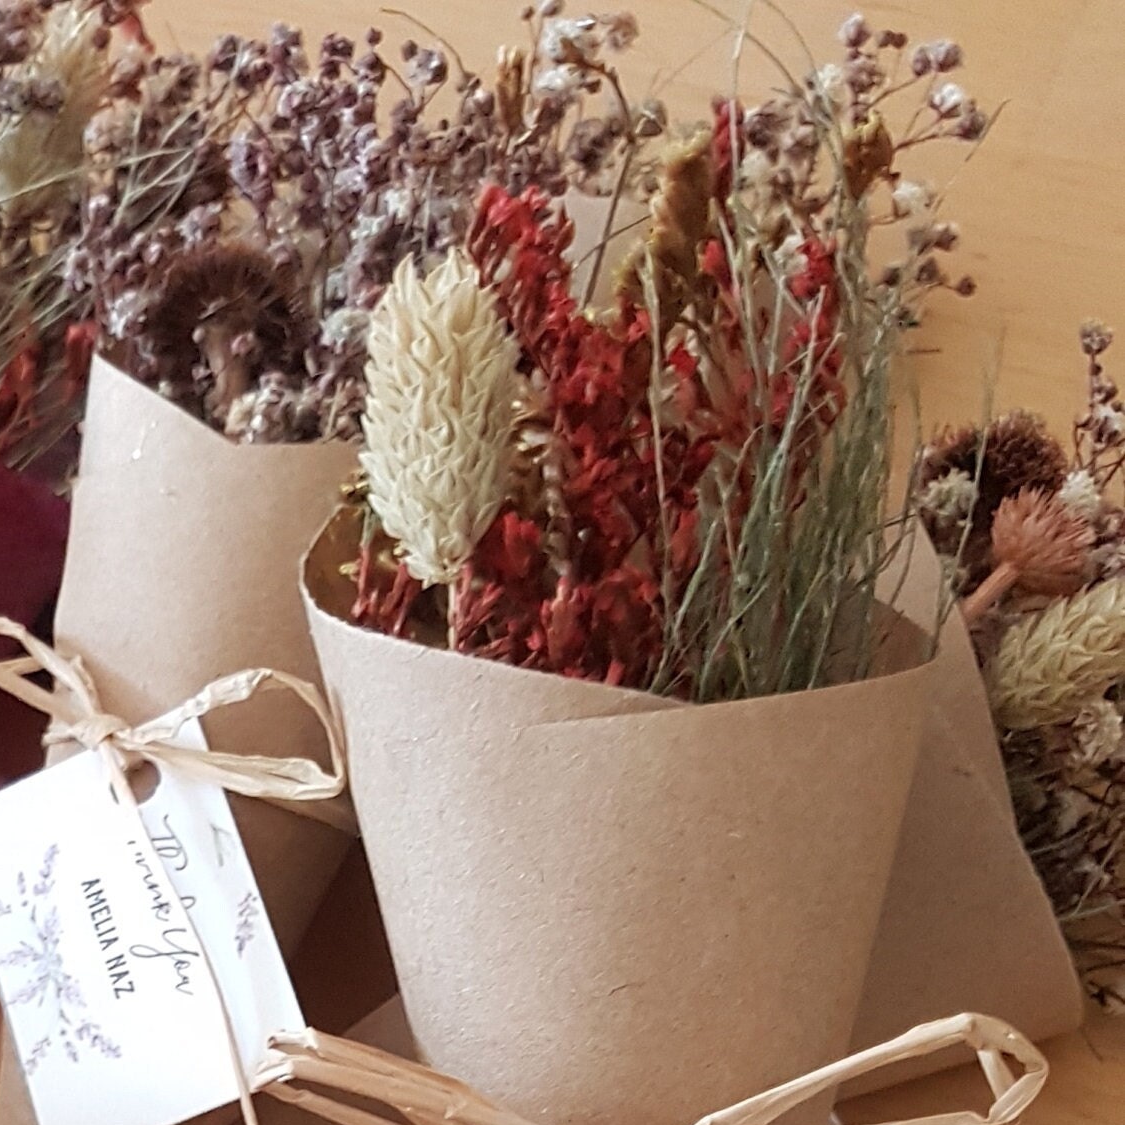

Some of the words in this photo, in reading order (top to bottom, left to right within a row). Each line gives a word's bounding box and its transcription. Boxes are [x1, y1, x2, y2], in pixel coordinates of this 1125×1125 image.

[81, 878, 119, 951] AMELIA
[105, 953, 135, 999] NAZ
[129, 928, 199, 995] You
